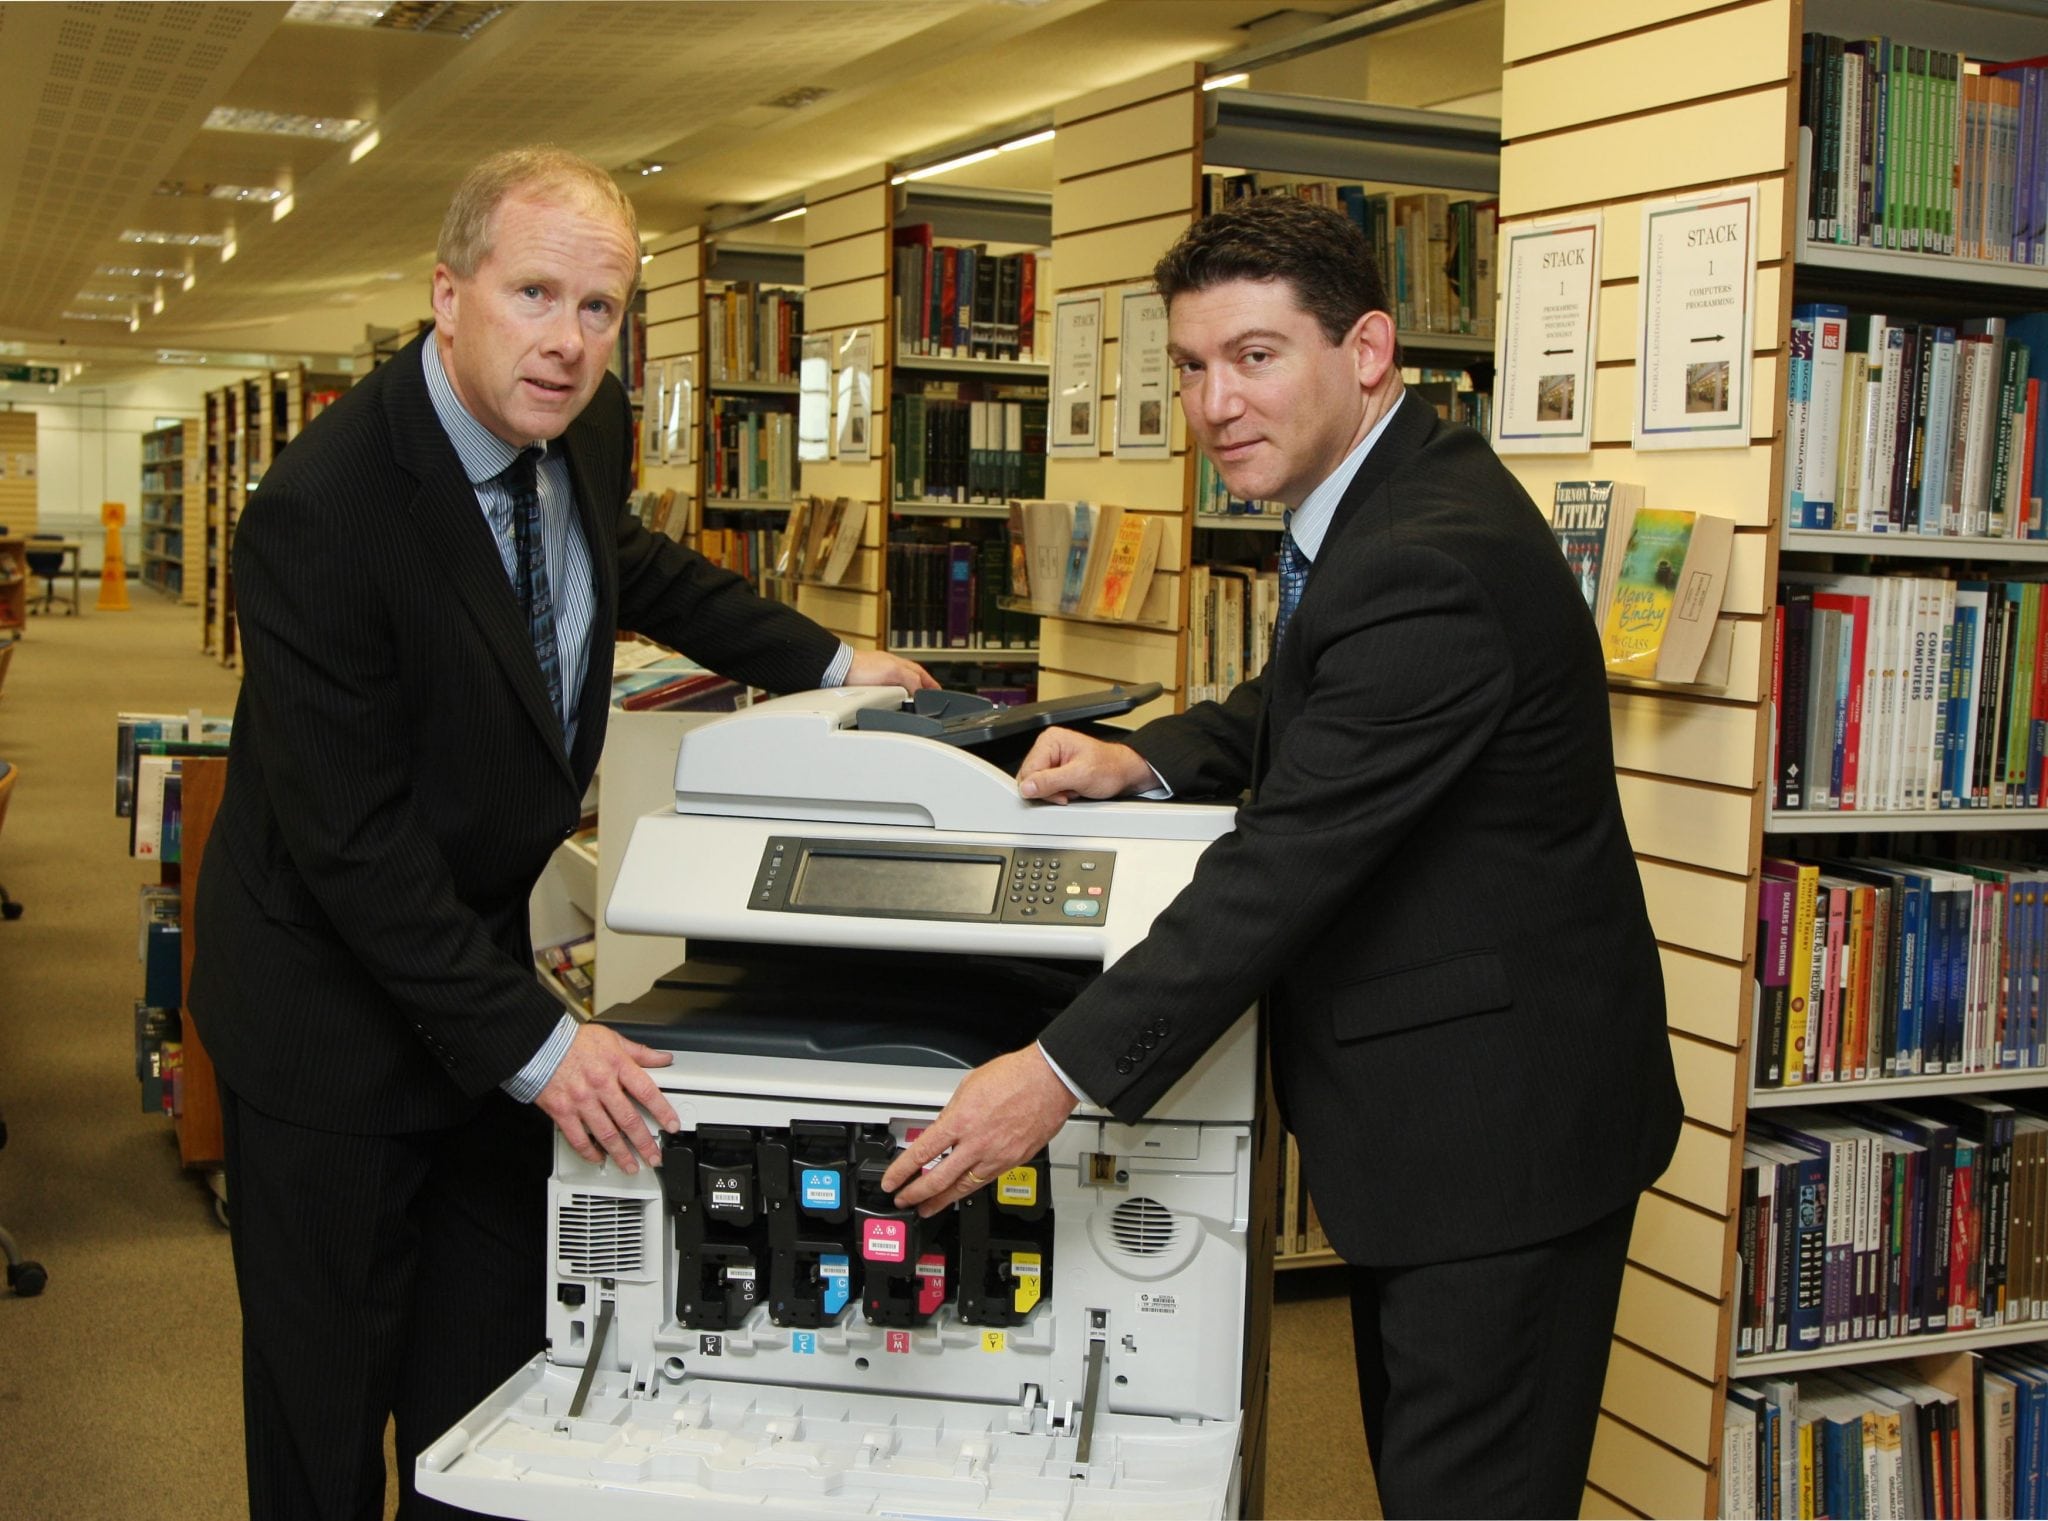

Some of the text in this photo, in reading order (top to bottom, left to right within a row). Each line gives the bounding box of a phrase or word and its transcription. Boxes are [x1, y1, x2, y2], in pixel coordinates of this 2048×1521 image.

[1687, 223, 1738, 248] STACK
[1542, 248, 1585, 269] STACK
[1686, 298, 1735, 310] PROGRAMMING
[1689, 285, 1732, 297] COMPUTERS
[1900, 368, 1913, 422] Simulation
[1959, 355, 1974, 442] CODING THEORY
[1797, 362, 1810, 490] SUCCESSFUL SIMULATION
[1553, 504, 1606, 529] LITTLE
[1619, 602, 1666, 632] Binchy
[1911, 632, 1924, 701] COMPUTERS
[1924, 632, 1937, 701] COMPUTERS
[1837, 663, 1849, 744] Computer Science
[1781, 892, 1790, 925] DEALERS
[1814, 943, 1822, 952] AS
[1815, 921, 1824, 939] FREE
[1778, 938, 1788, 976] LIGHTNING
[1810, 966, 1821, 1002] FREEDOM
[1832, 1166, 1840, 1217] COMPUTERS
[1859, 1167, 1867, 1217] COMPUTERS
[1946, 1174, 1954, 1187] The
[1943, 1208, 1952, 1266] Microprocessors
[1779, 1208, 1792, 1314] BEYOND CALCULATION
[1799, 1234, 1812, 1308] PIONEERS
[1813, 1232, 1823, 1306] COMPUTER
[1988, 1247, 1996, 1266] Design
[708, 1344, 714, 1352] K
[990, 1340, 996, 1348] Y
[1732, 1433, 1740, 1512] Practical SSADM
[1870, 1456, 1878, 1503] STRUCTURED
